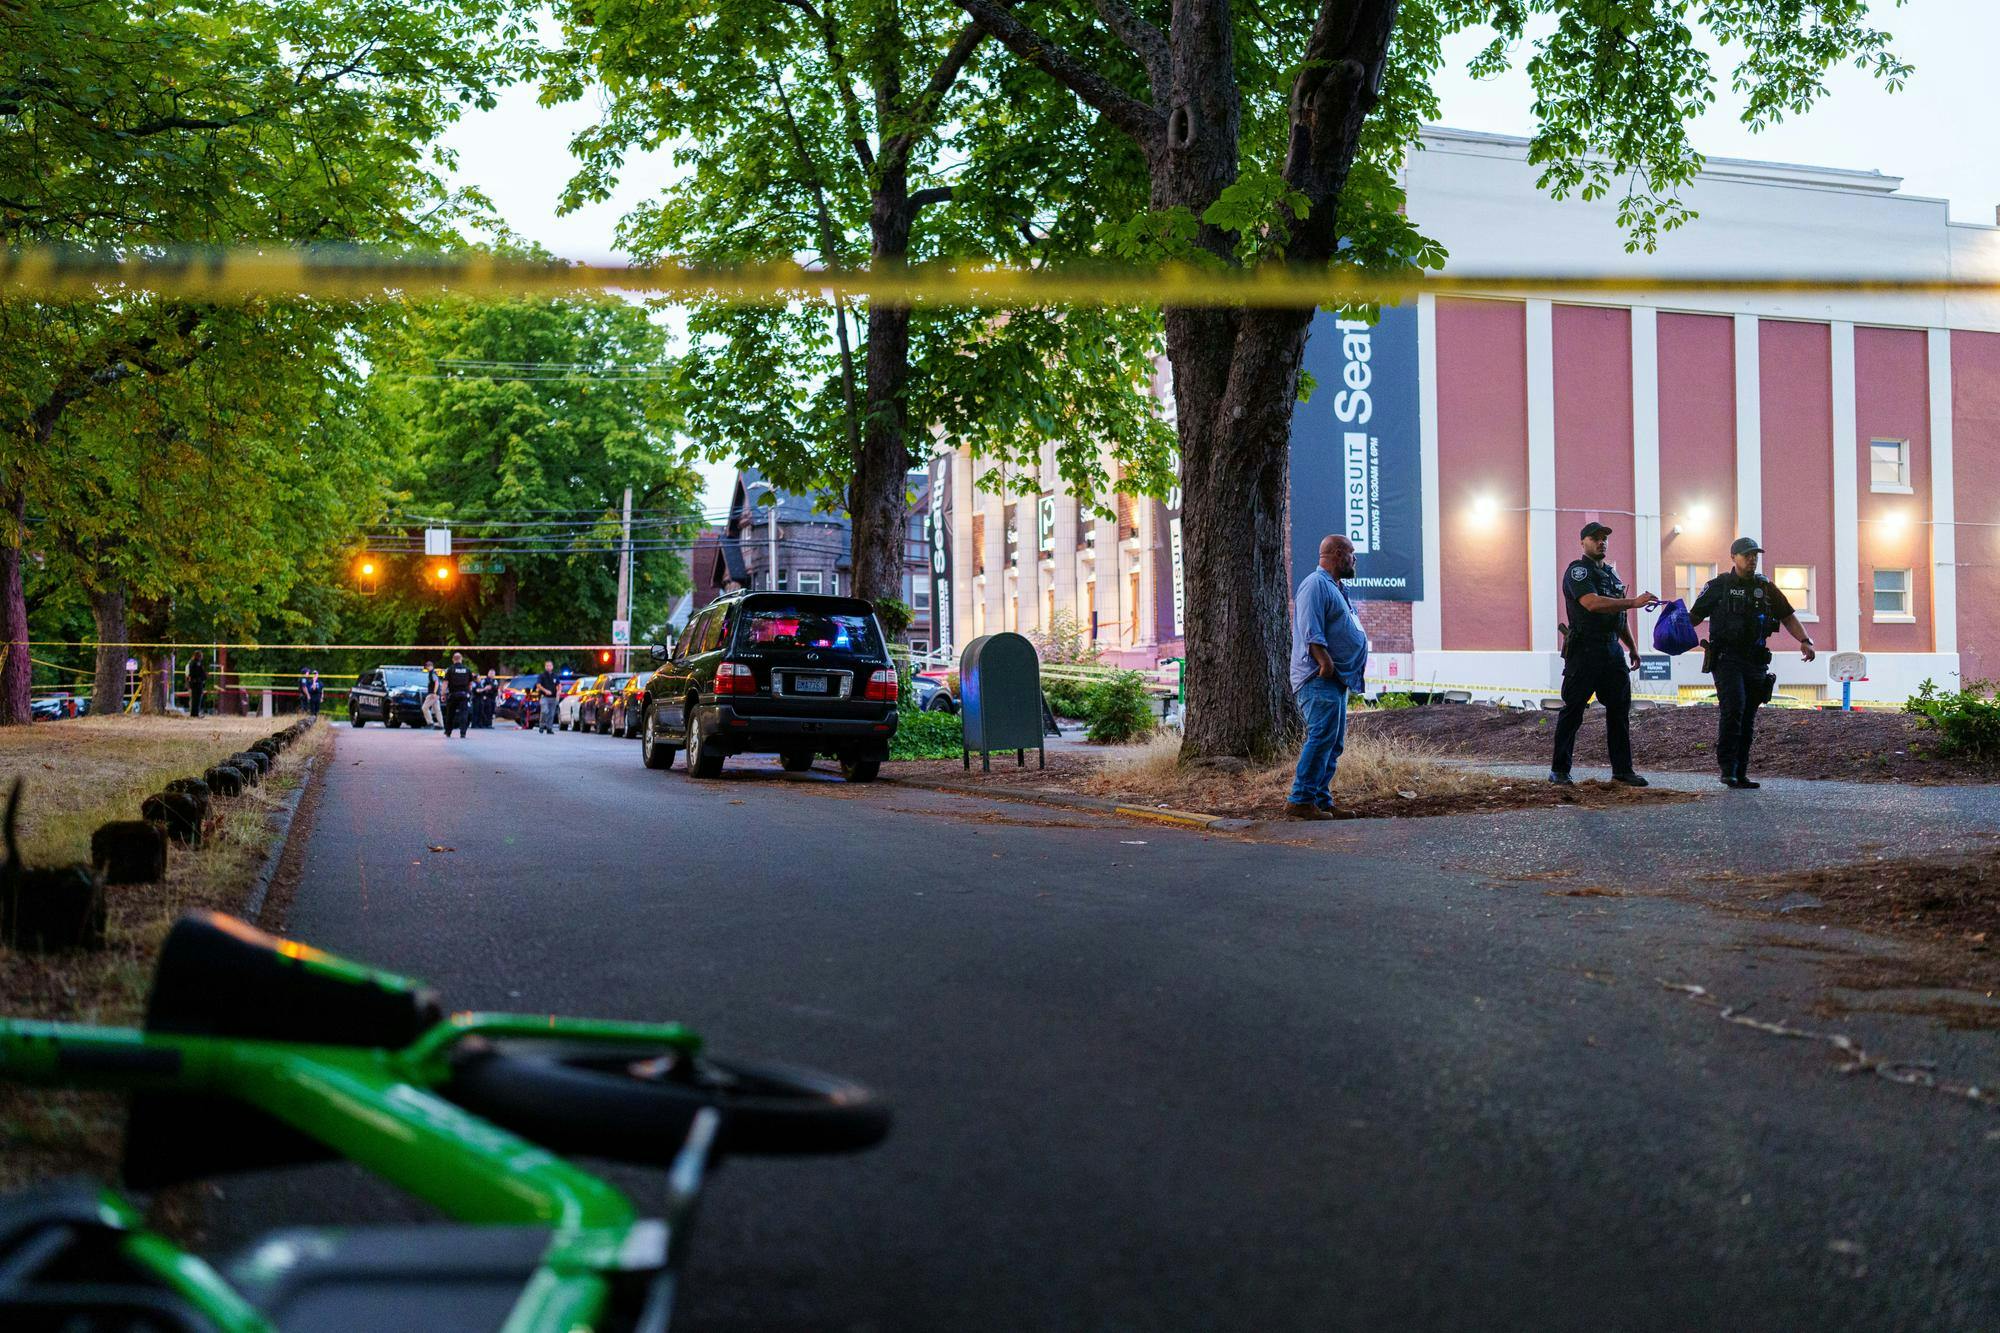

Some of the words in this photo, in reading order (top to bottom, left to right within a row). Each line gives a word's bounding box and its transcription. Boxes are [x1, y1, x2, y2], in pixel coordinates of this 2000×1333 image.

[1334, 303, 1372, 424] Seat
[932, 459, 946, 574] Seattle
[1350, 444, 1364, 542] PURSUIT
[1370, 466, 1380, 503] 10:30AM
[1371, 510, 1381, 551] SUNDAYS
[1173, 529, 1183, 625] PURSUIT
[1340, 577, 1407, 588] RSUITNW.COM
